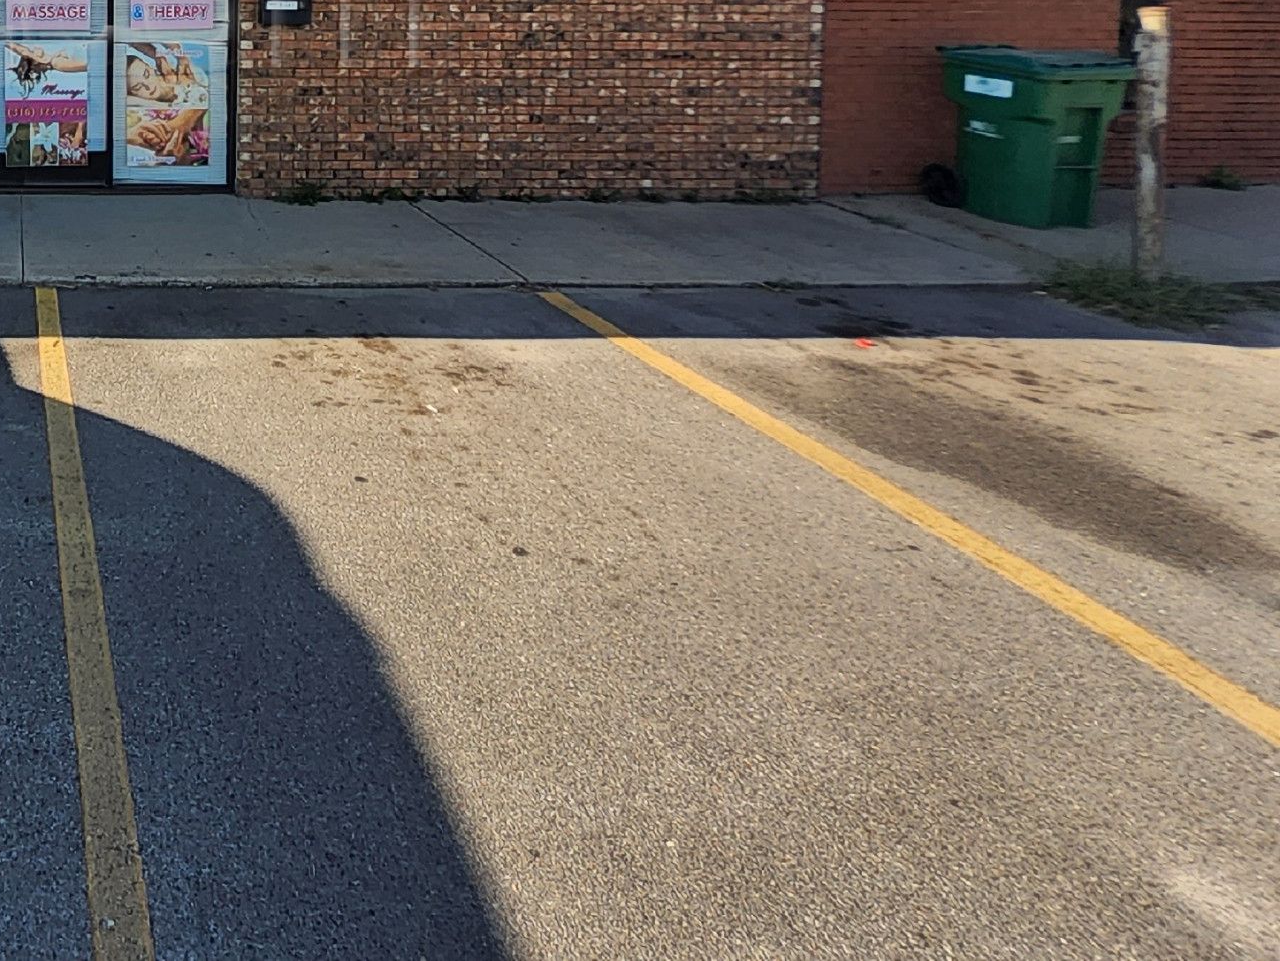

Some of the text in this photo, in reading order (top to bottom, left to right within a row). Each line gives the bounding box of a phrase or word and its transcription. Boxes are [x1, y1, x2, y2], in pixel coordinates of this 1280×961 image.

[11, 4, 88, 20] MASSAGE
[132, 4, 209, 20] & THERAPY
